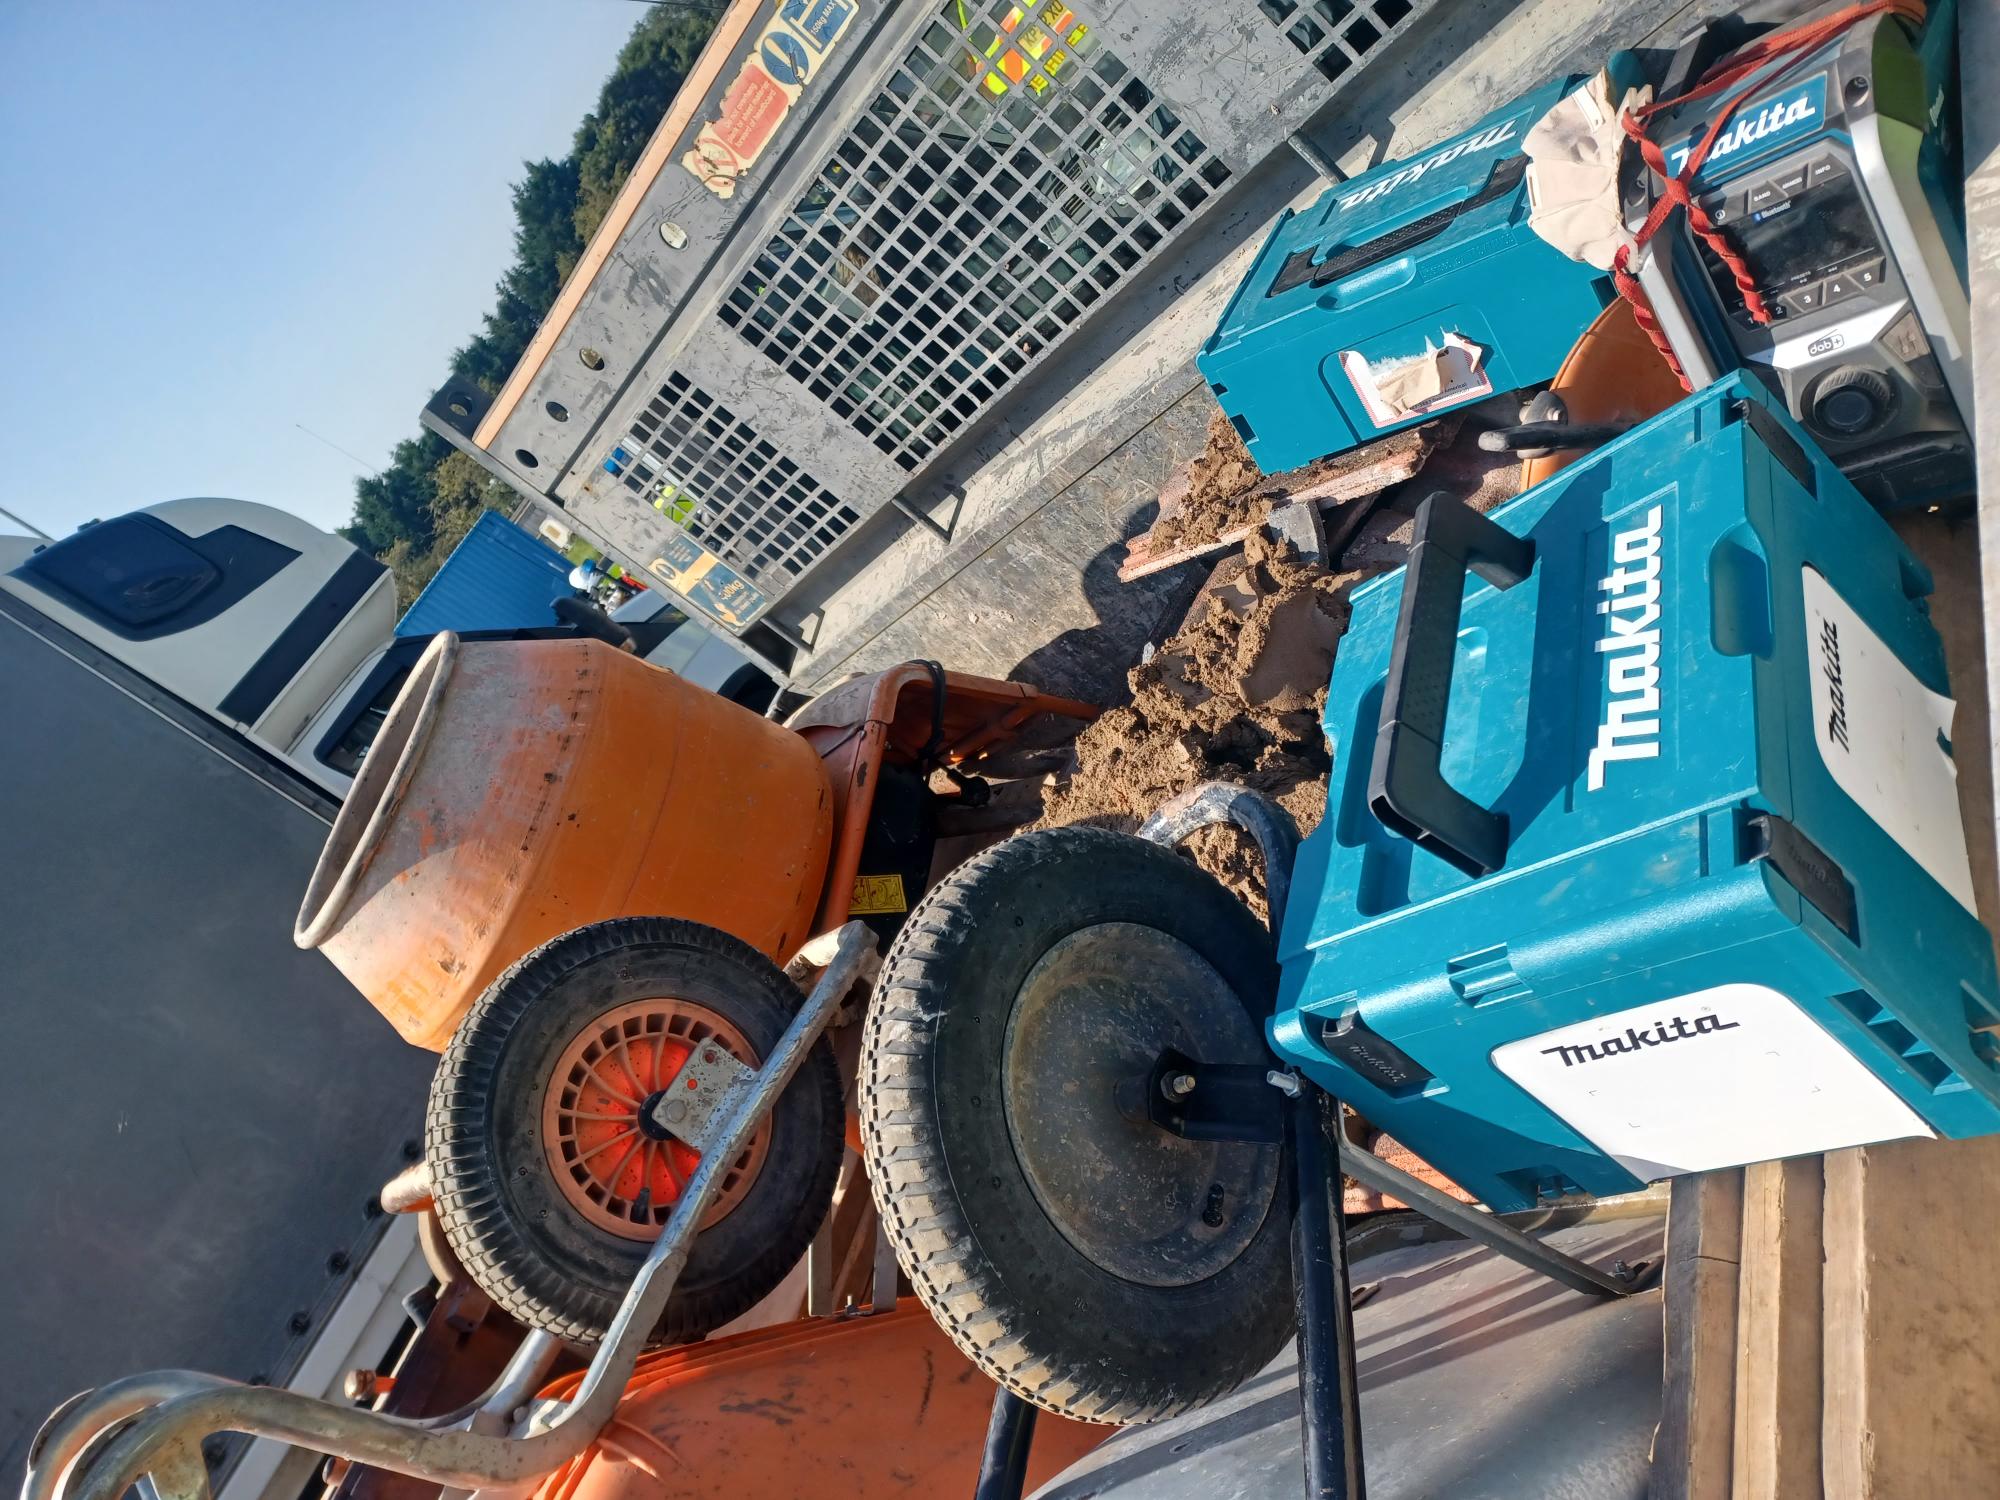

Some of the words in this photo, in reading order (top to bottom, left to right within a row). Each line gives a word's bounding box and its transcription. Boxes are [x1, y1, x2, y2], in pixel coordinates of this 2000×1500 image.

[1775, 306, 1784, 315] 2
[1803, 295, 1812, 304] 3
[1833, 284, 1841, 293] 4
[1863, 272, 1872, 282] 5
